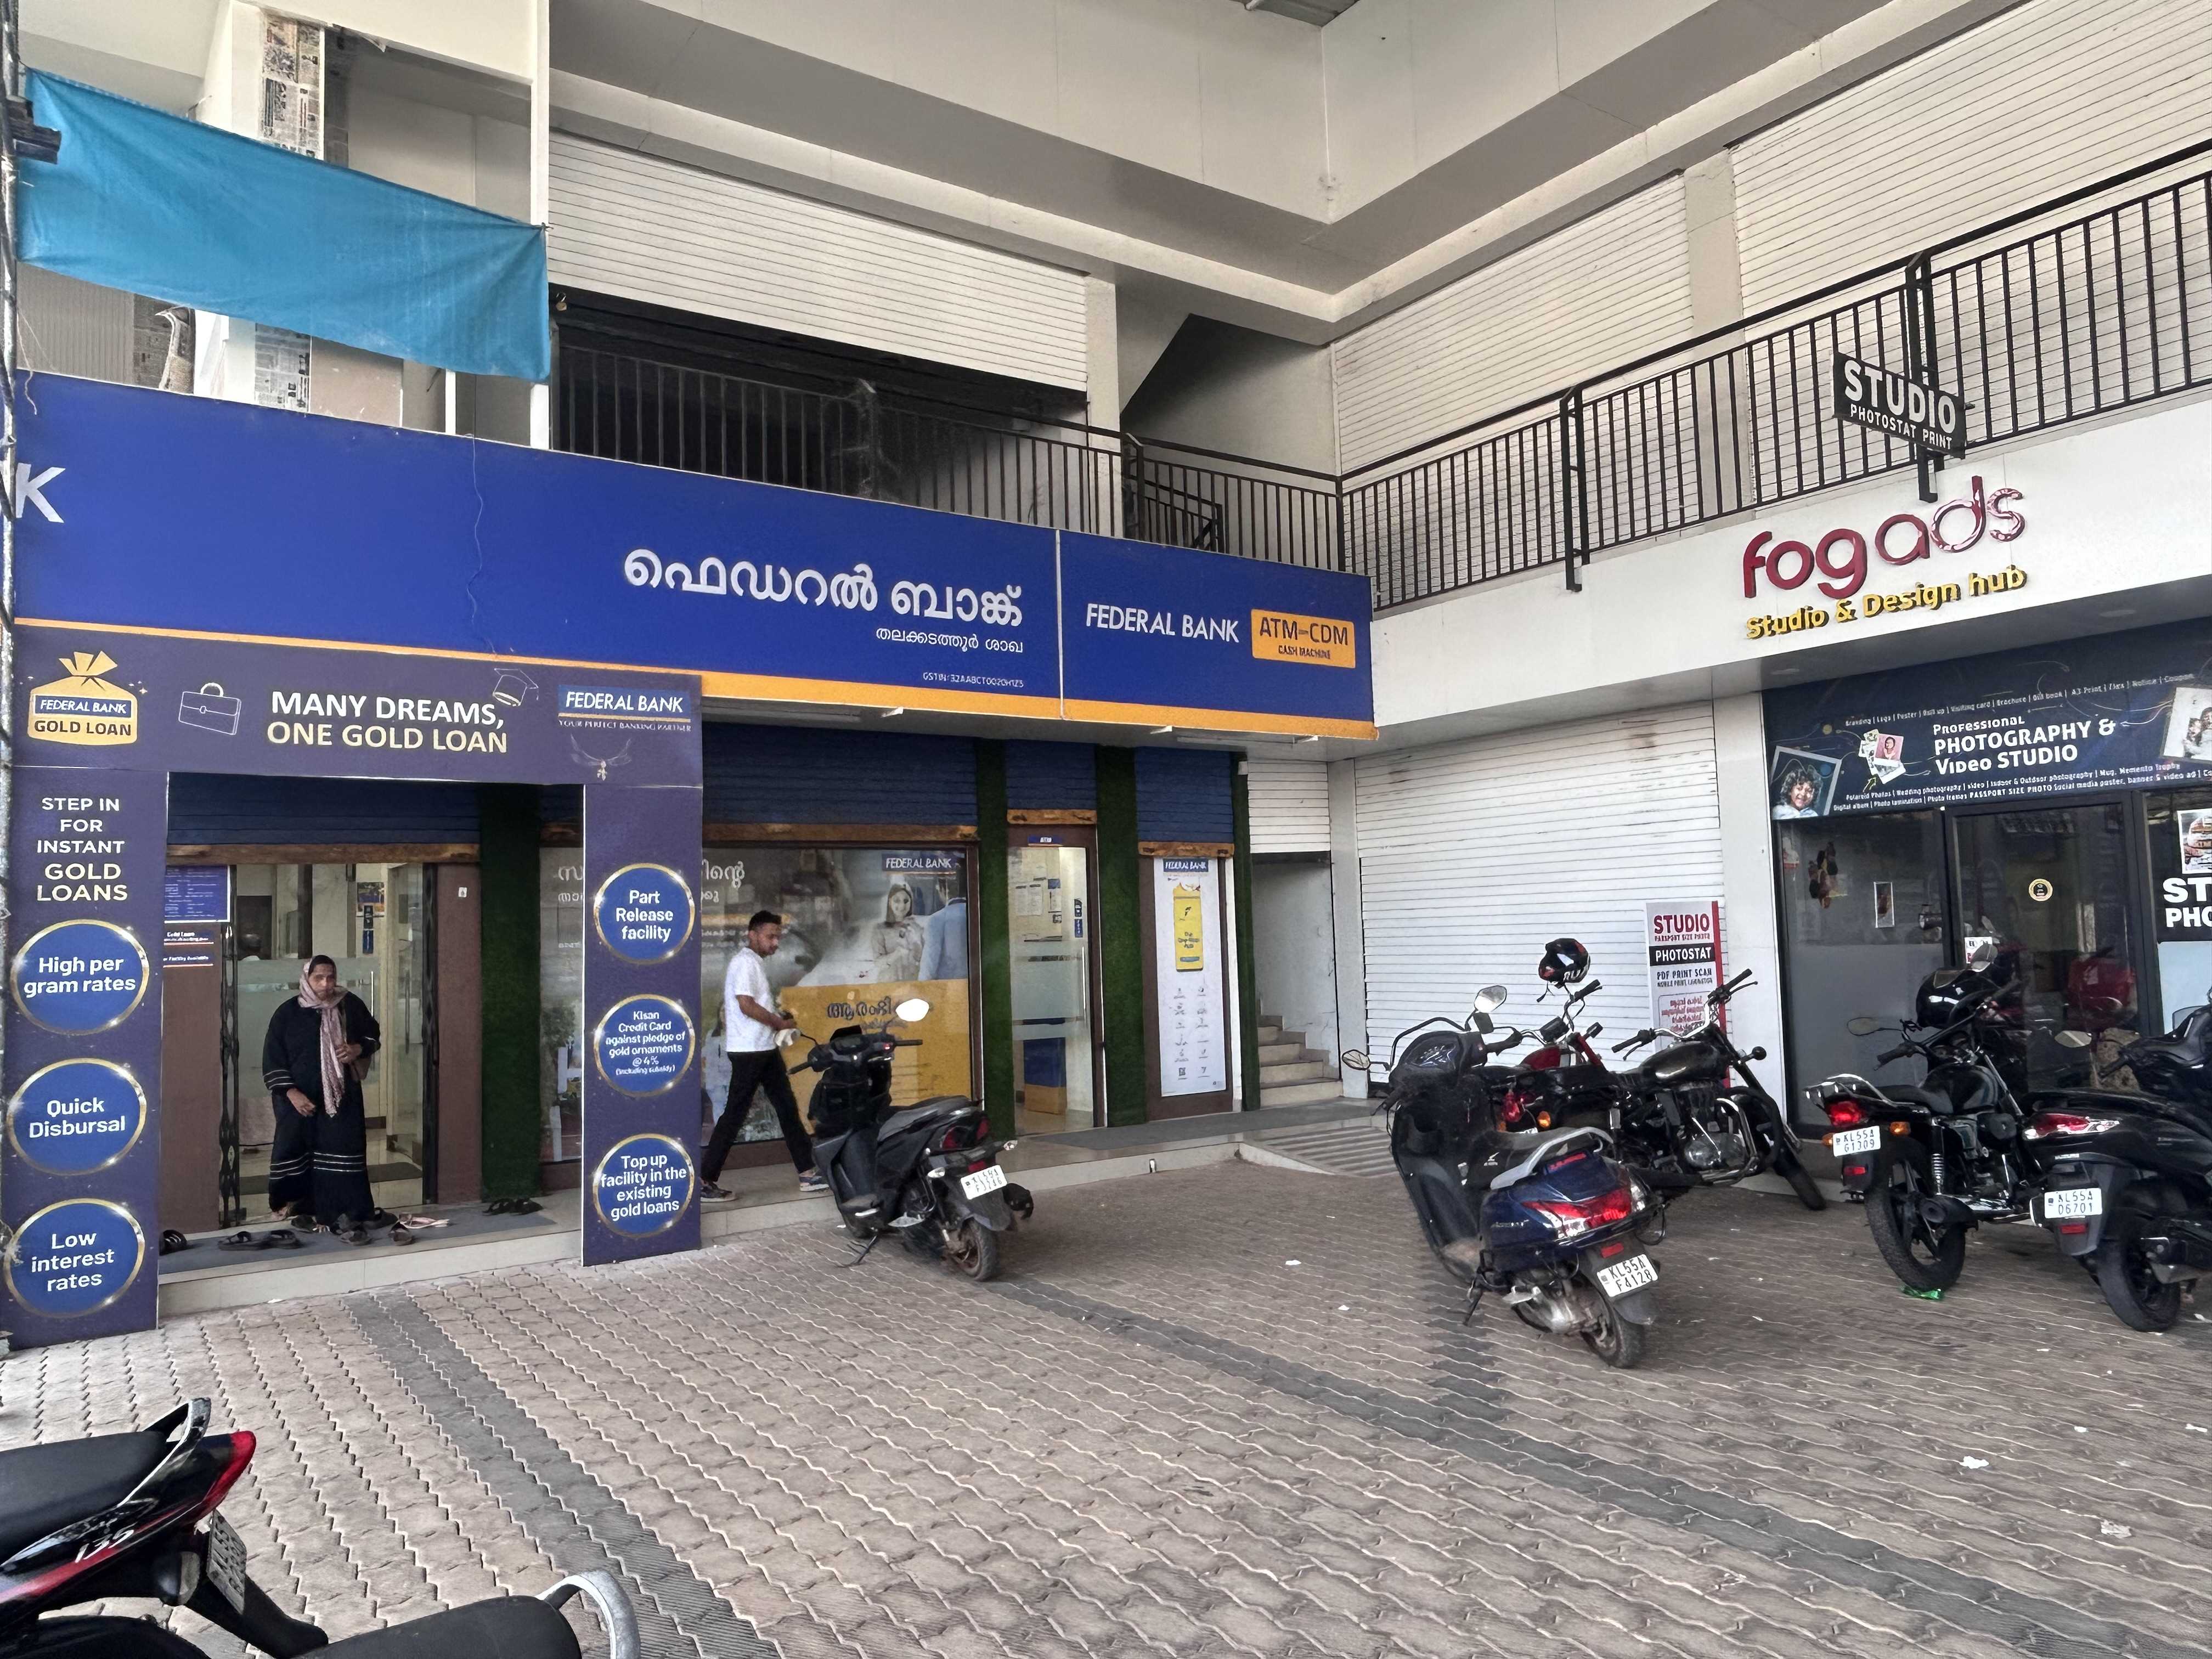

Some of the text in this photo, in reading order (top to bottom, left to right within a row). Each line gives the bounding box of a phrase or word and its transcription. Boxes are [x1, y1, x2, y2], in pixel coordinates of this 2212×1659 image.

[1844, 360, 1956, 433] STUDIO
[1850, 403, 1953, 450] PHOTOSTAT PRINT
[624, 549, 1023, 626] ഫെഡറൽ ബാങ്ക്
[1746, 564, 2028, 640] Studio & Design hub
[1086, 603, 1239, 643] FEDERAL BANK
[985, 639, 1023, 653] ശാഖ
[1278, 645, 1297, 656] CASH
[40, 699, 127, 714] FEDERAL BANK
[272, 691, 504, 729] MANY DREAMS,
[566, 691, 683, 713] FEDERAL BANK
[34, 720, 131, 736] GOLD LOAN
[267, 721, 507, 753] ONE GOLD LOAN
[1934, 719, 2116, 755] PHOTOGRAPHY &
[1997, 744, 2078, 769] STUDIO
[1970, 789, 2006, 798] PASSPORT
[2008, 787, 2024, 795] SIZE
[2027, 785, 2052, 793] PHOTO
[42, 798, 120, 811] STEP IN
[60, 819, 103, 832] FOR
[37, 840, 125, 854] INSTANT
[886, 857, 952, 868] FEDERAL BANK
[44, 863, 121, 880] GOLD
[37, 884, 128, 901] LOANS
[629, 890, 661, 904] Part
[616, 907, 674, 922] Release
[1654, 913, 1709, 934] STUDIO
[622, 925, 672, 943] facility
[1656, 947, 1711, 962] PHOTOSTAT
[39, 957, 124, 976] High per
[1657, 970, 1669, 980] PDF
[24, 977, 136, 998] gram rates
[633, 1011, 659, 1020] Kisan
[618, 1021, 672, 1032] Credit Card
[606, 1031, 686, 1046] against pledge of
[609, 1044, 682, 1058] gold ornaments
[47, 1097, 104, 1118] Quick
[29, 1115, 125, 1138] Disbursal
[620, 1155, 668, 1170] Top up
[601, 1167, 687, 1188] facility in the
[616, 1184, 672, 1202] existing
[611, 1200, 680, 1221] gold loans
[52, 1233, 97, 1249] Low
[31, 1249, 115, 1273] interest
[47, 1273, 102, 1292] rates
